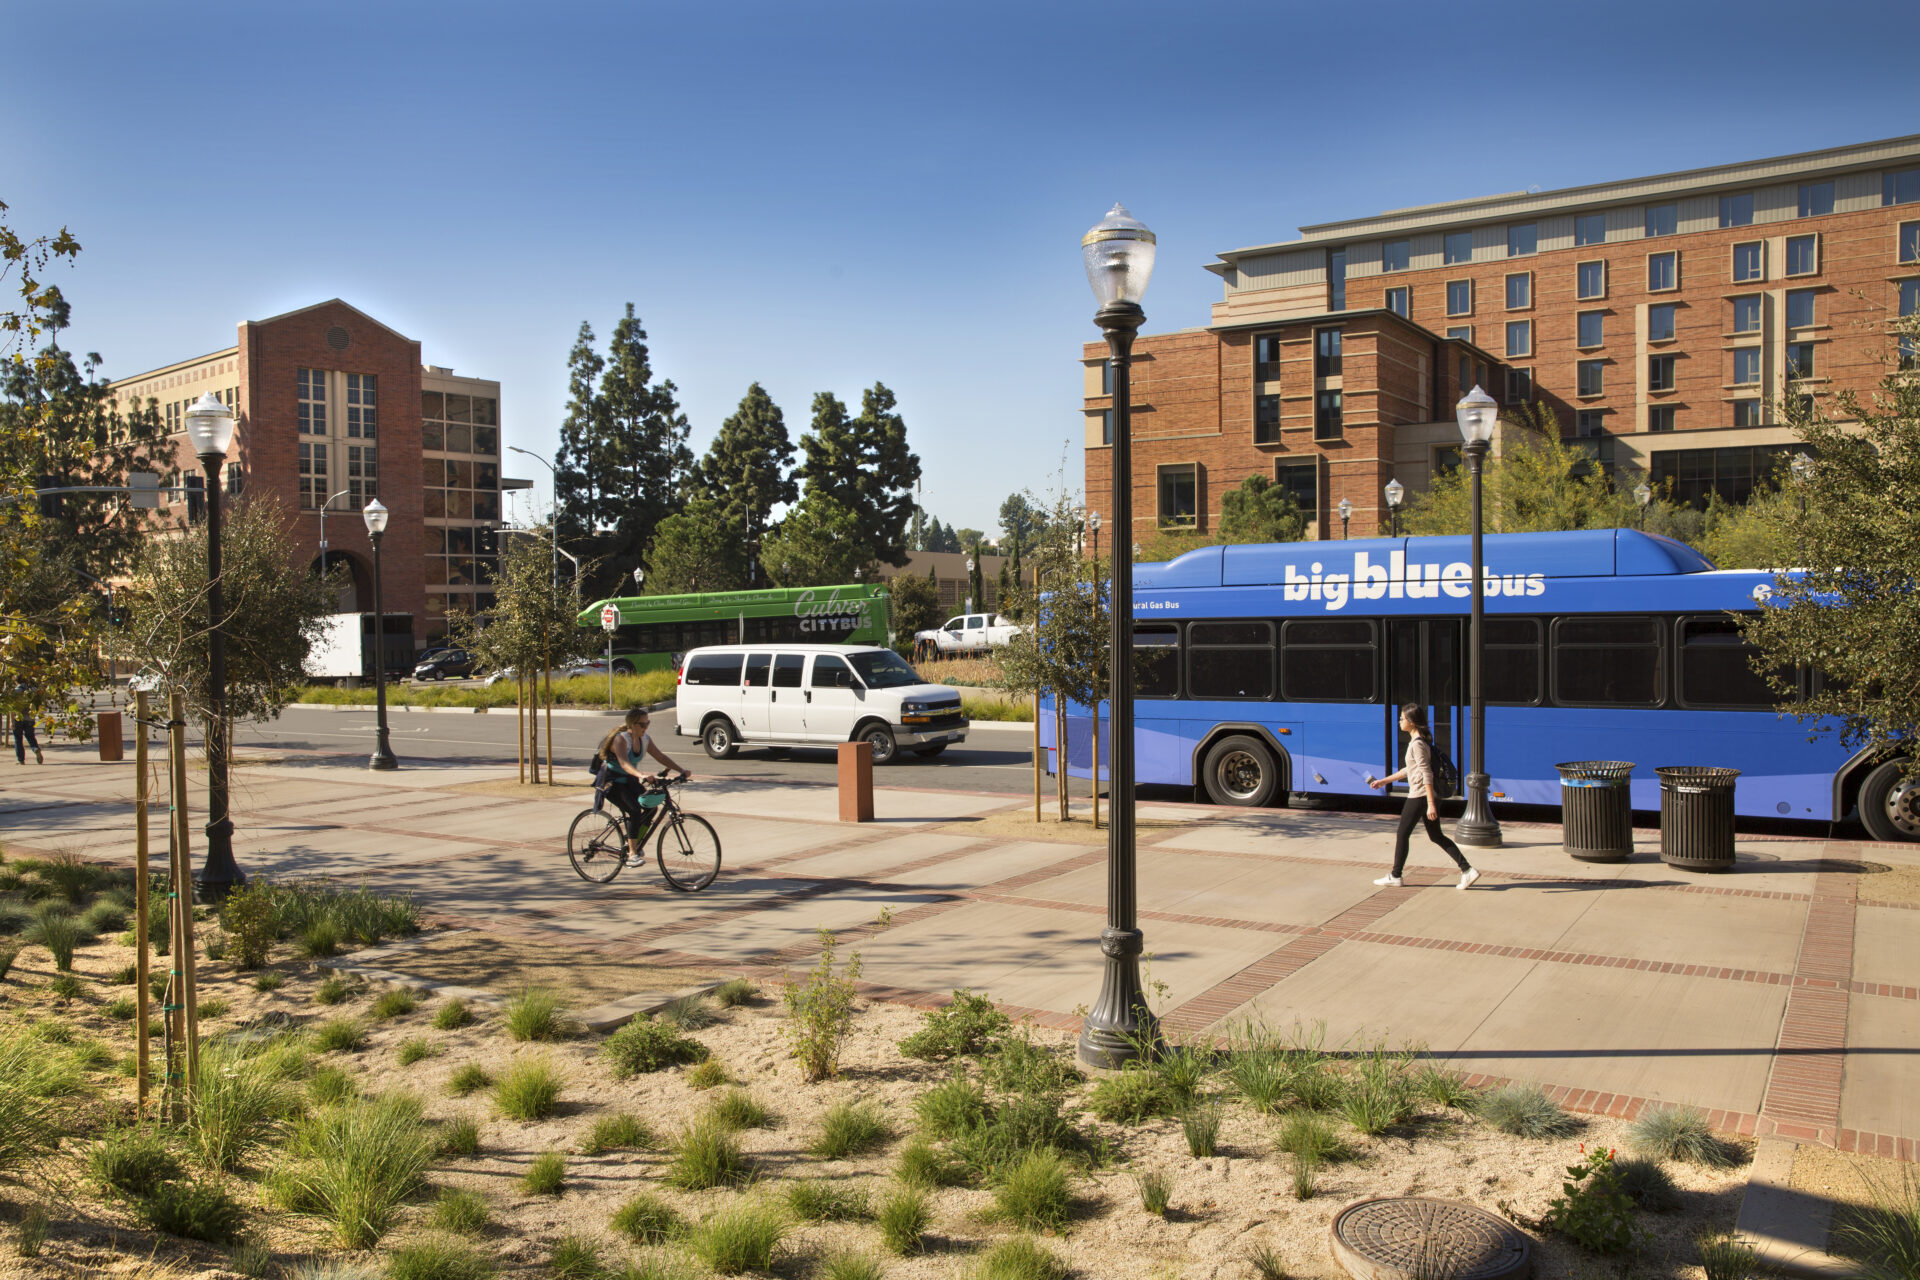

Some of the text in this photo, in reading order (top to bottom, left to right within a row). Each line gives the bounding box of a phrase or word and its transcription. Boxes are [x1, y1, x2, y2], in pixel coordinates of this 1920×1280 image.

[1284, 550, 1546, 611] big blue bus
[794, 588, 871, 618] Culver
[1150, 601, 1164, 609] Gas
[1165, 601, 1180, 609] Bus
[799, 616, 872, 632] CITYBUS
